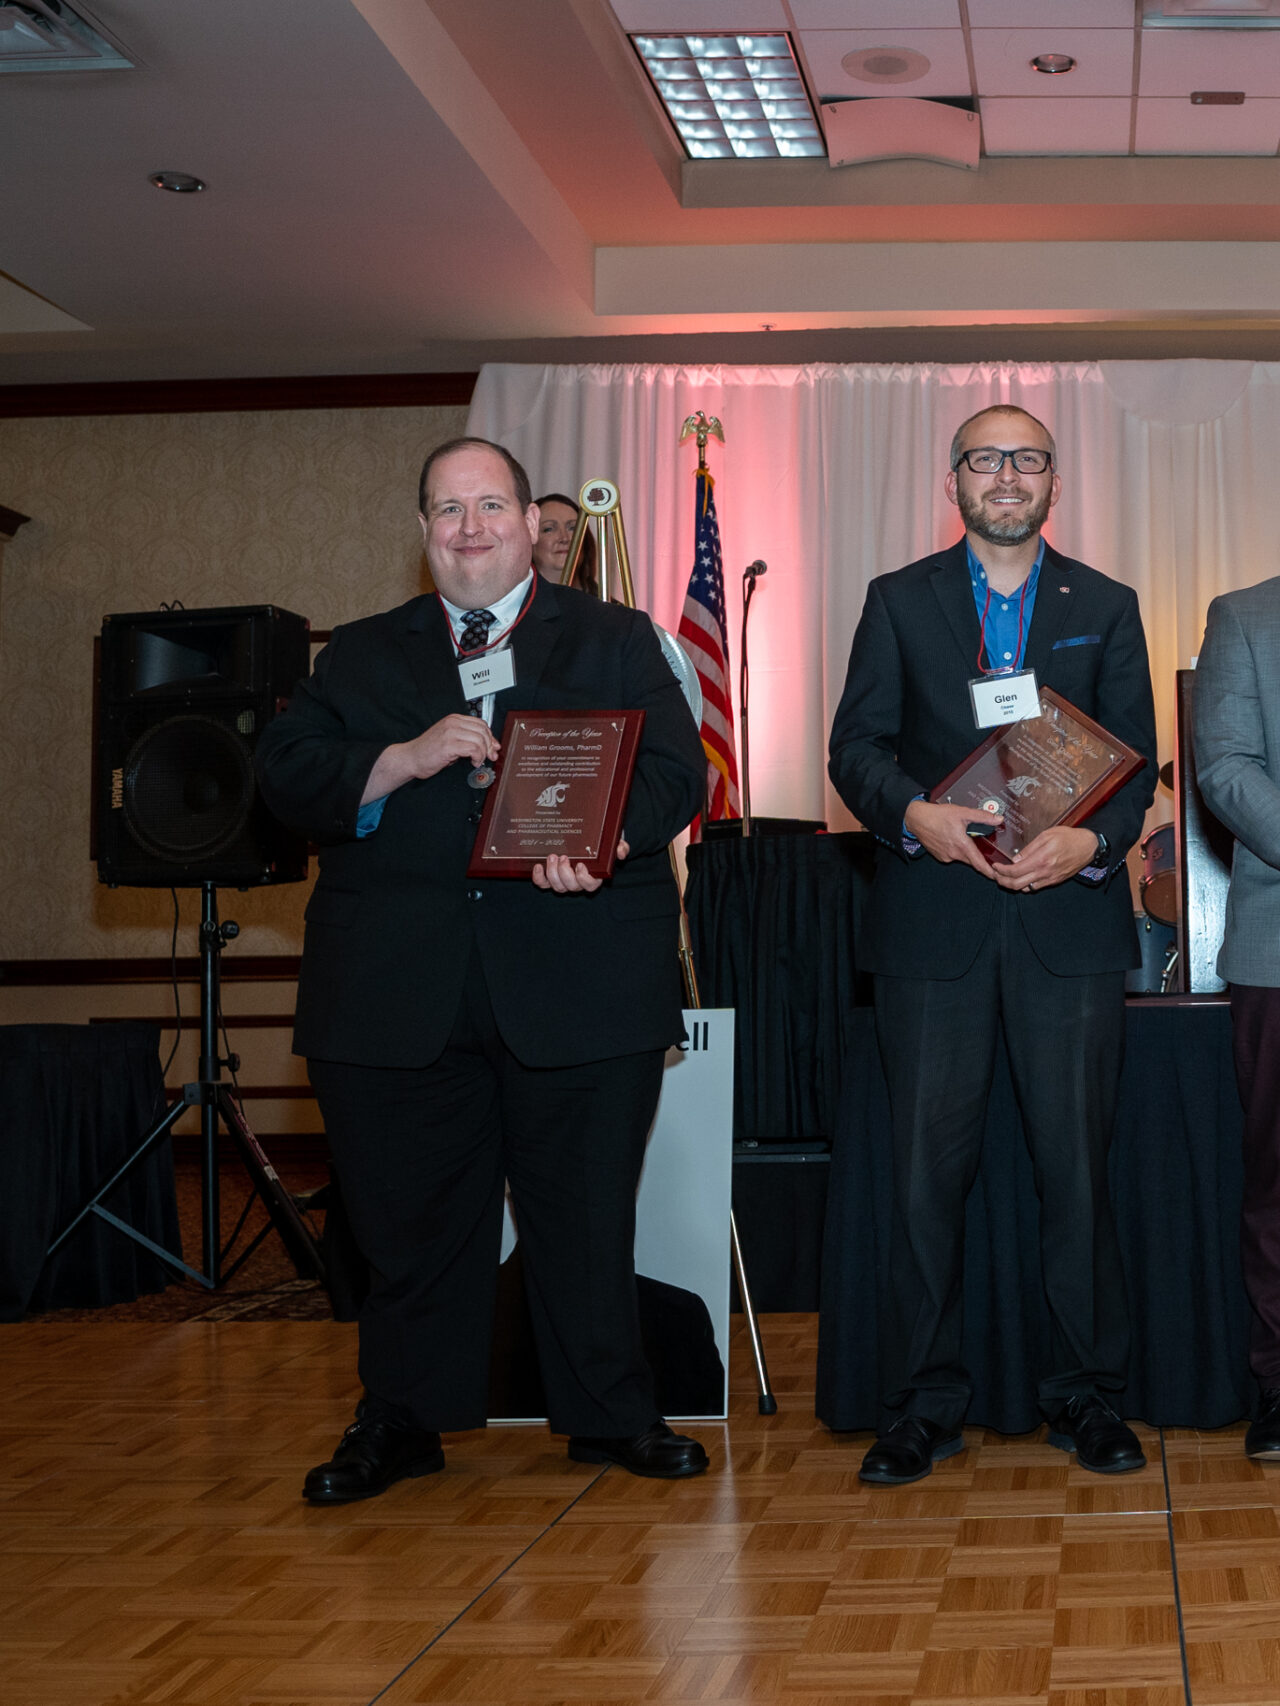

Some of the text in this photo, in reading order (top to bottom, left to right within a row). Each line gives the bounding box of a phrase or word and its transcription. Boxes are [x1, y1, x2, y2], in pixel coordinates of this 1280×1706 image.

[471, 669, 490, 680] Will
[994, 694, 1018, 704] Glen
[112, 768, 123, 808] YAMAHA
